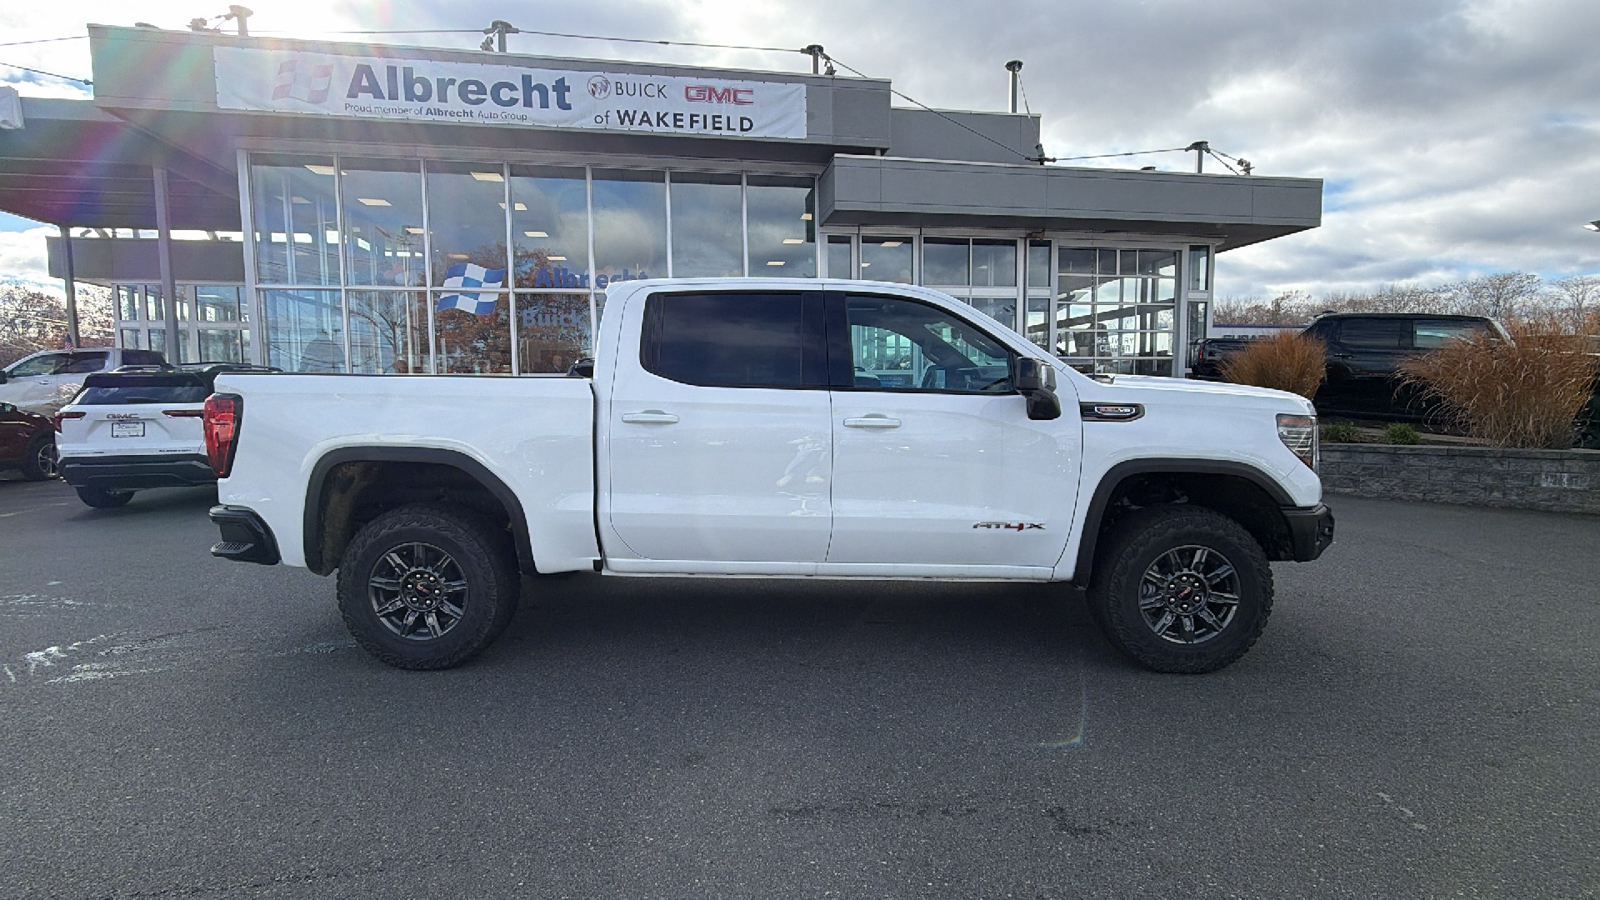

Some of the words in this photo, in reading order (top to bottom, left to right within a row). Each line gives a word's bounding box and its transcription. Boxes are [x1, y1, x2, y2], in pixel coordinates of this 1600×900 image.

[346, 63, 572, 110] Albrecht
[614, 81, 667, 99] BUICK
[685, 84, 754, 105] GMC
[344, 102, 372, 113] Proud
[374, 104, 412, 115] member
[413, 106, 423, 115] of
[425, 107, 474, 118] Albrecht
[477, 110, 499, 119] Auto
[500, 111, 528, 121] Group
[594, 110, 610, 125] of
[616, 109, 754, 132] WAKEFIELD
[522, 308, 584, 328] Buick
[973, 521, 1046, 532] AT4X
